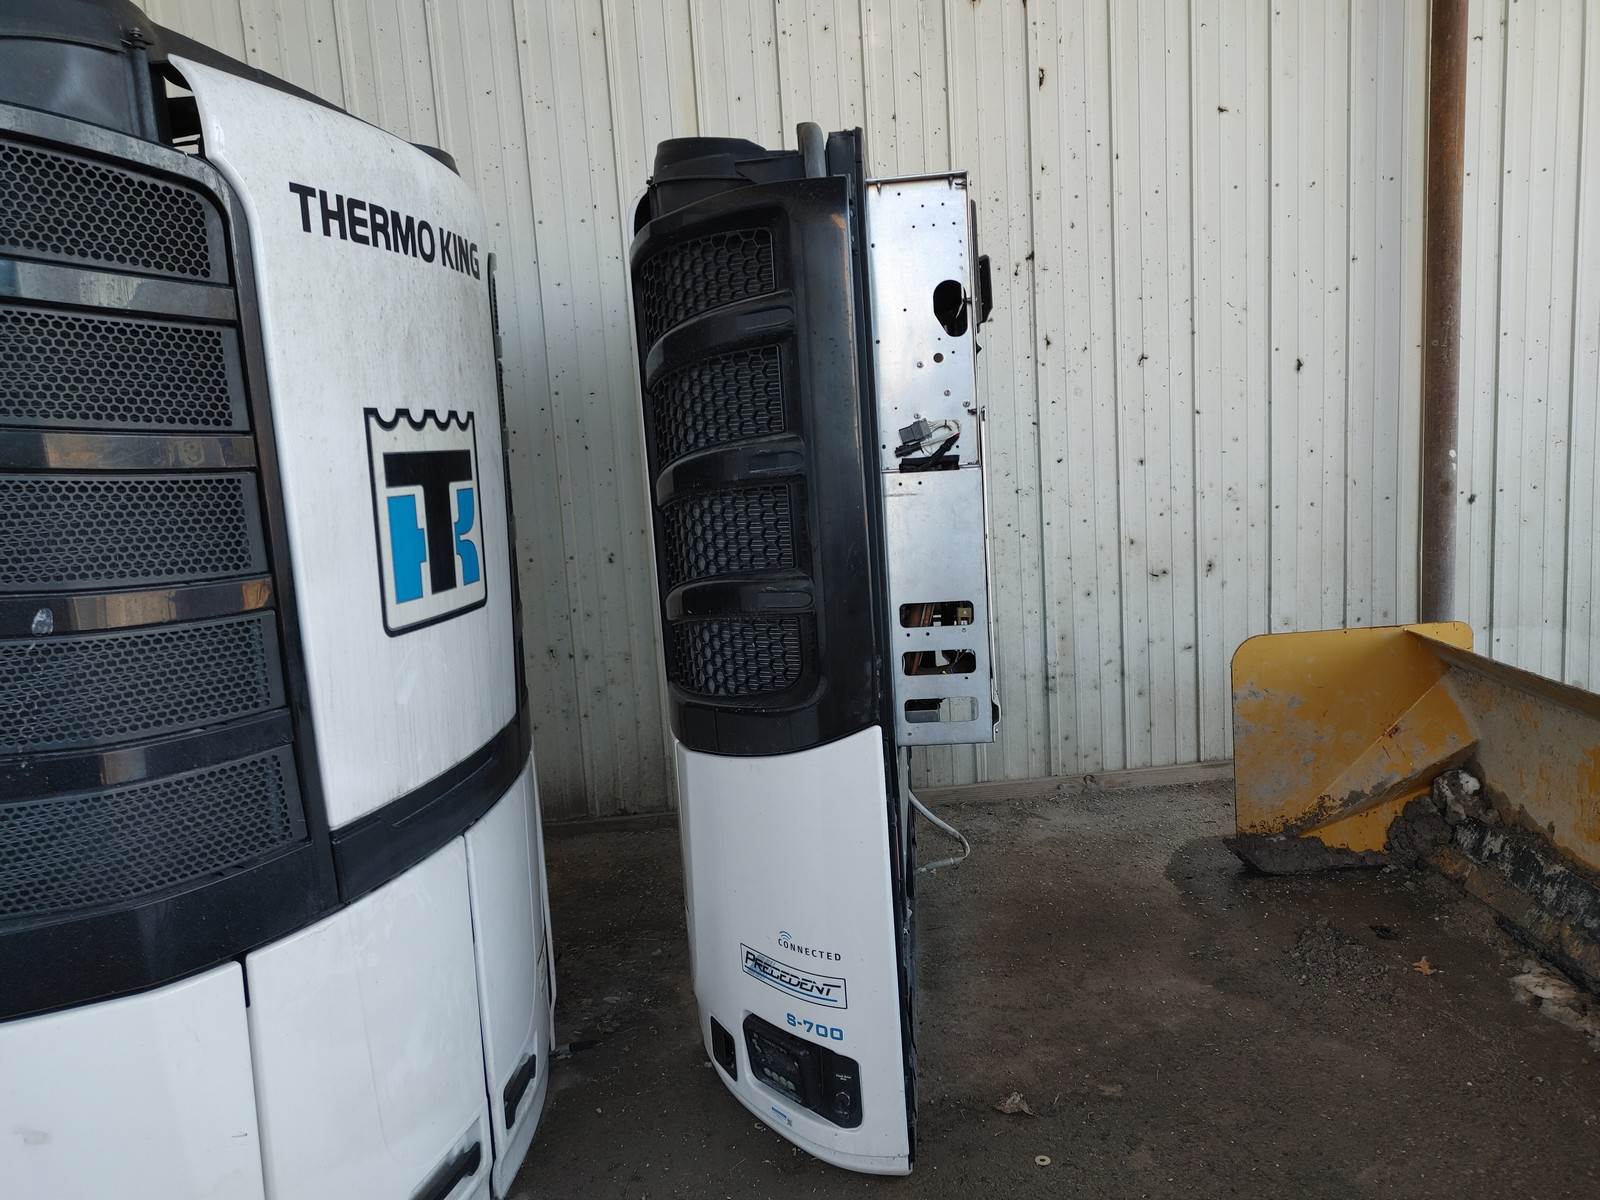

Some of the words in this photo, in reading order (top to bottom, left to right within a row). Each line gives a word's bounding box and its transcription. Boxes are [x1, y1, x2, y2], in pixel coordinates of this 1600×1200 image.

[288, 181, 436, 264] THERMO
[439, 226, 481, 281] KING
[777, 938, 842, 962] CONNECTED
[744, 950, 842, 997] PRECEDENT
[786, 1012, 844, 1041] S-700
